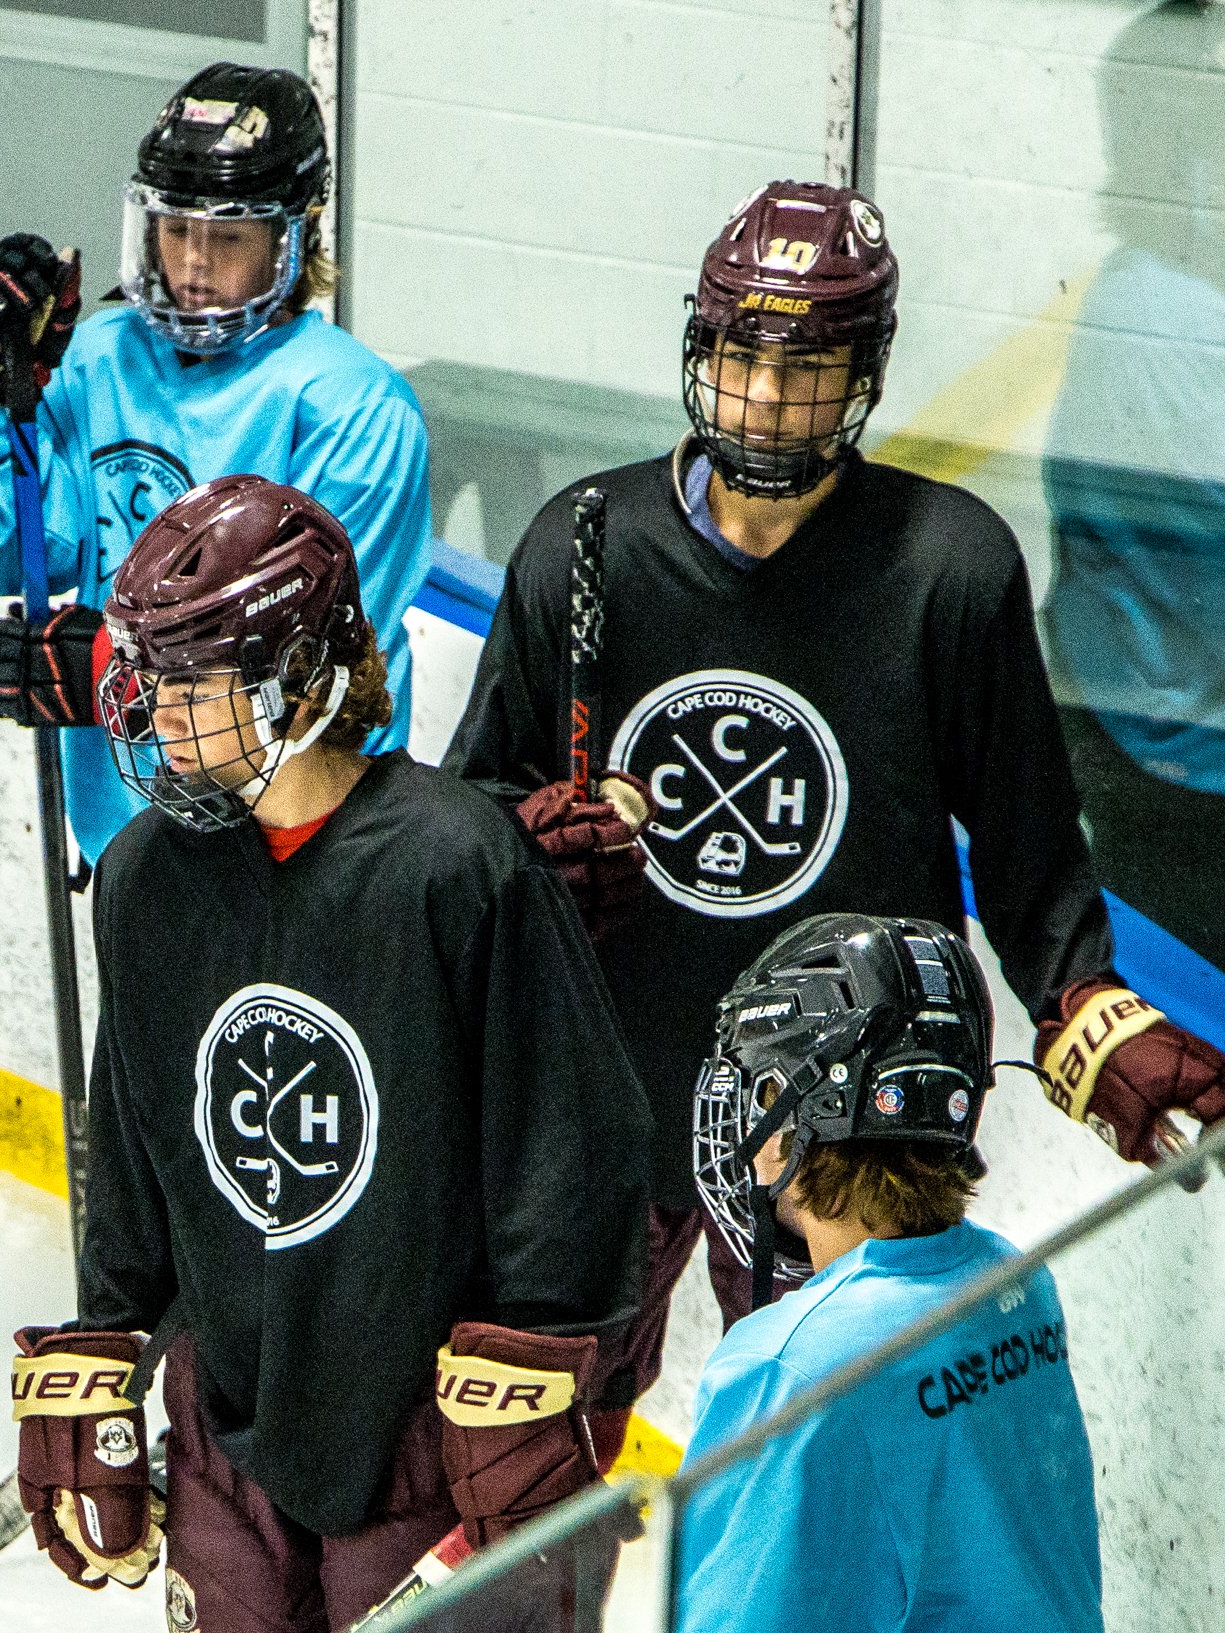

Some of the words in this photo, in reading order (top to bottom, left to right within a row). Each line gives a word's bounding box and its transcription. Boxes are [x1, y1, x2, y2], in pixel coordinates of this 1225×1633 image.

[763, 294, 813, 315] EAGLES
[245, 577, 303, 619] BAUER
[667, 693, 703, 719] CAPE
[704, 691, 737, 707] COD
[738, 694, 797, 731] HOCKEY
[712, 714, 750, 763] C
[650, 763, 687, 811] C
[766, 777, 807, 826] H
[225, 1010, 254, 1044] CAPE
[267, 1008, 325, 1044] HOCKEY
[739, 1002, 792, 1023] BAUER
[230, 1089, 264, 1139] C
[300, 1094, 339, 1144] H
[990, 1334, 1029, 1386] COD
